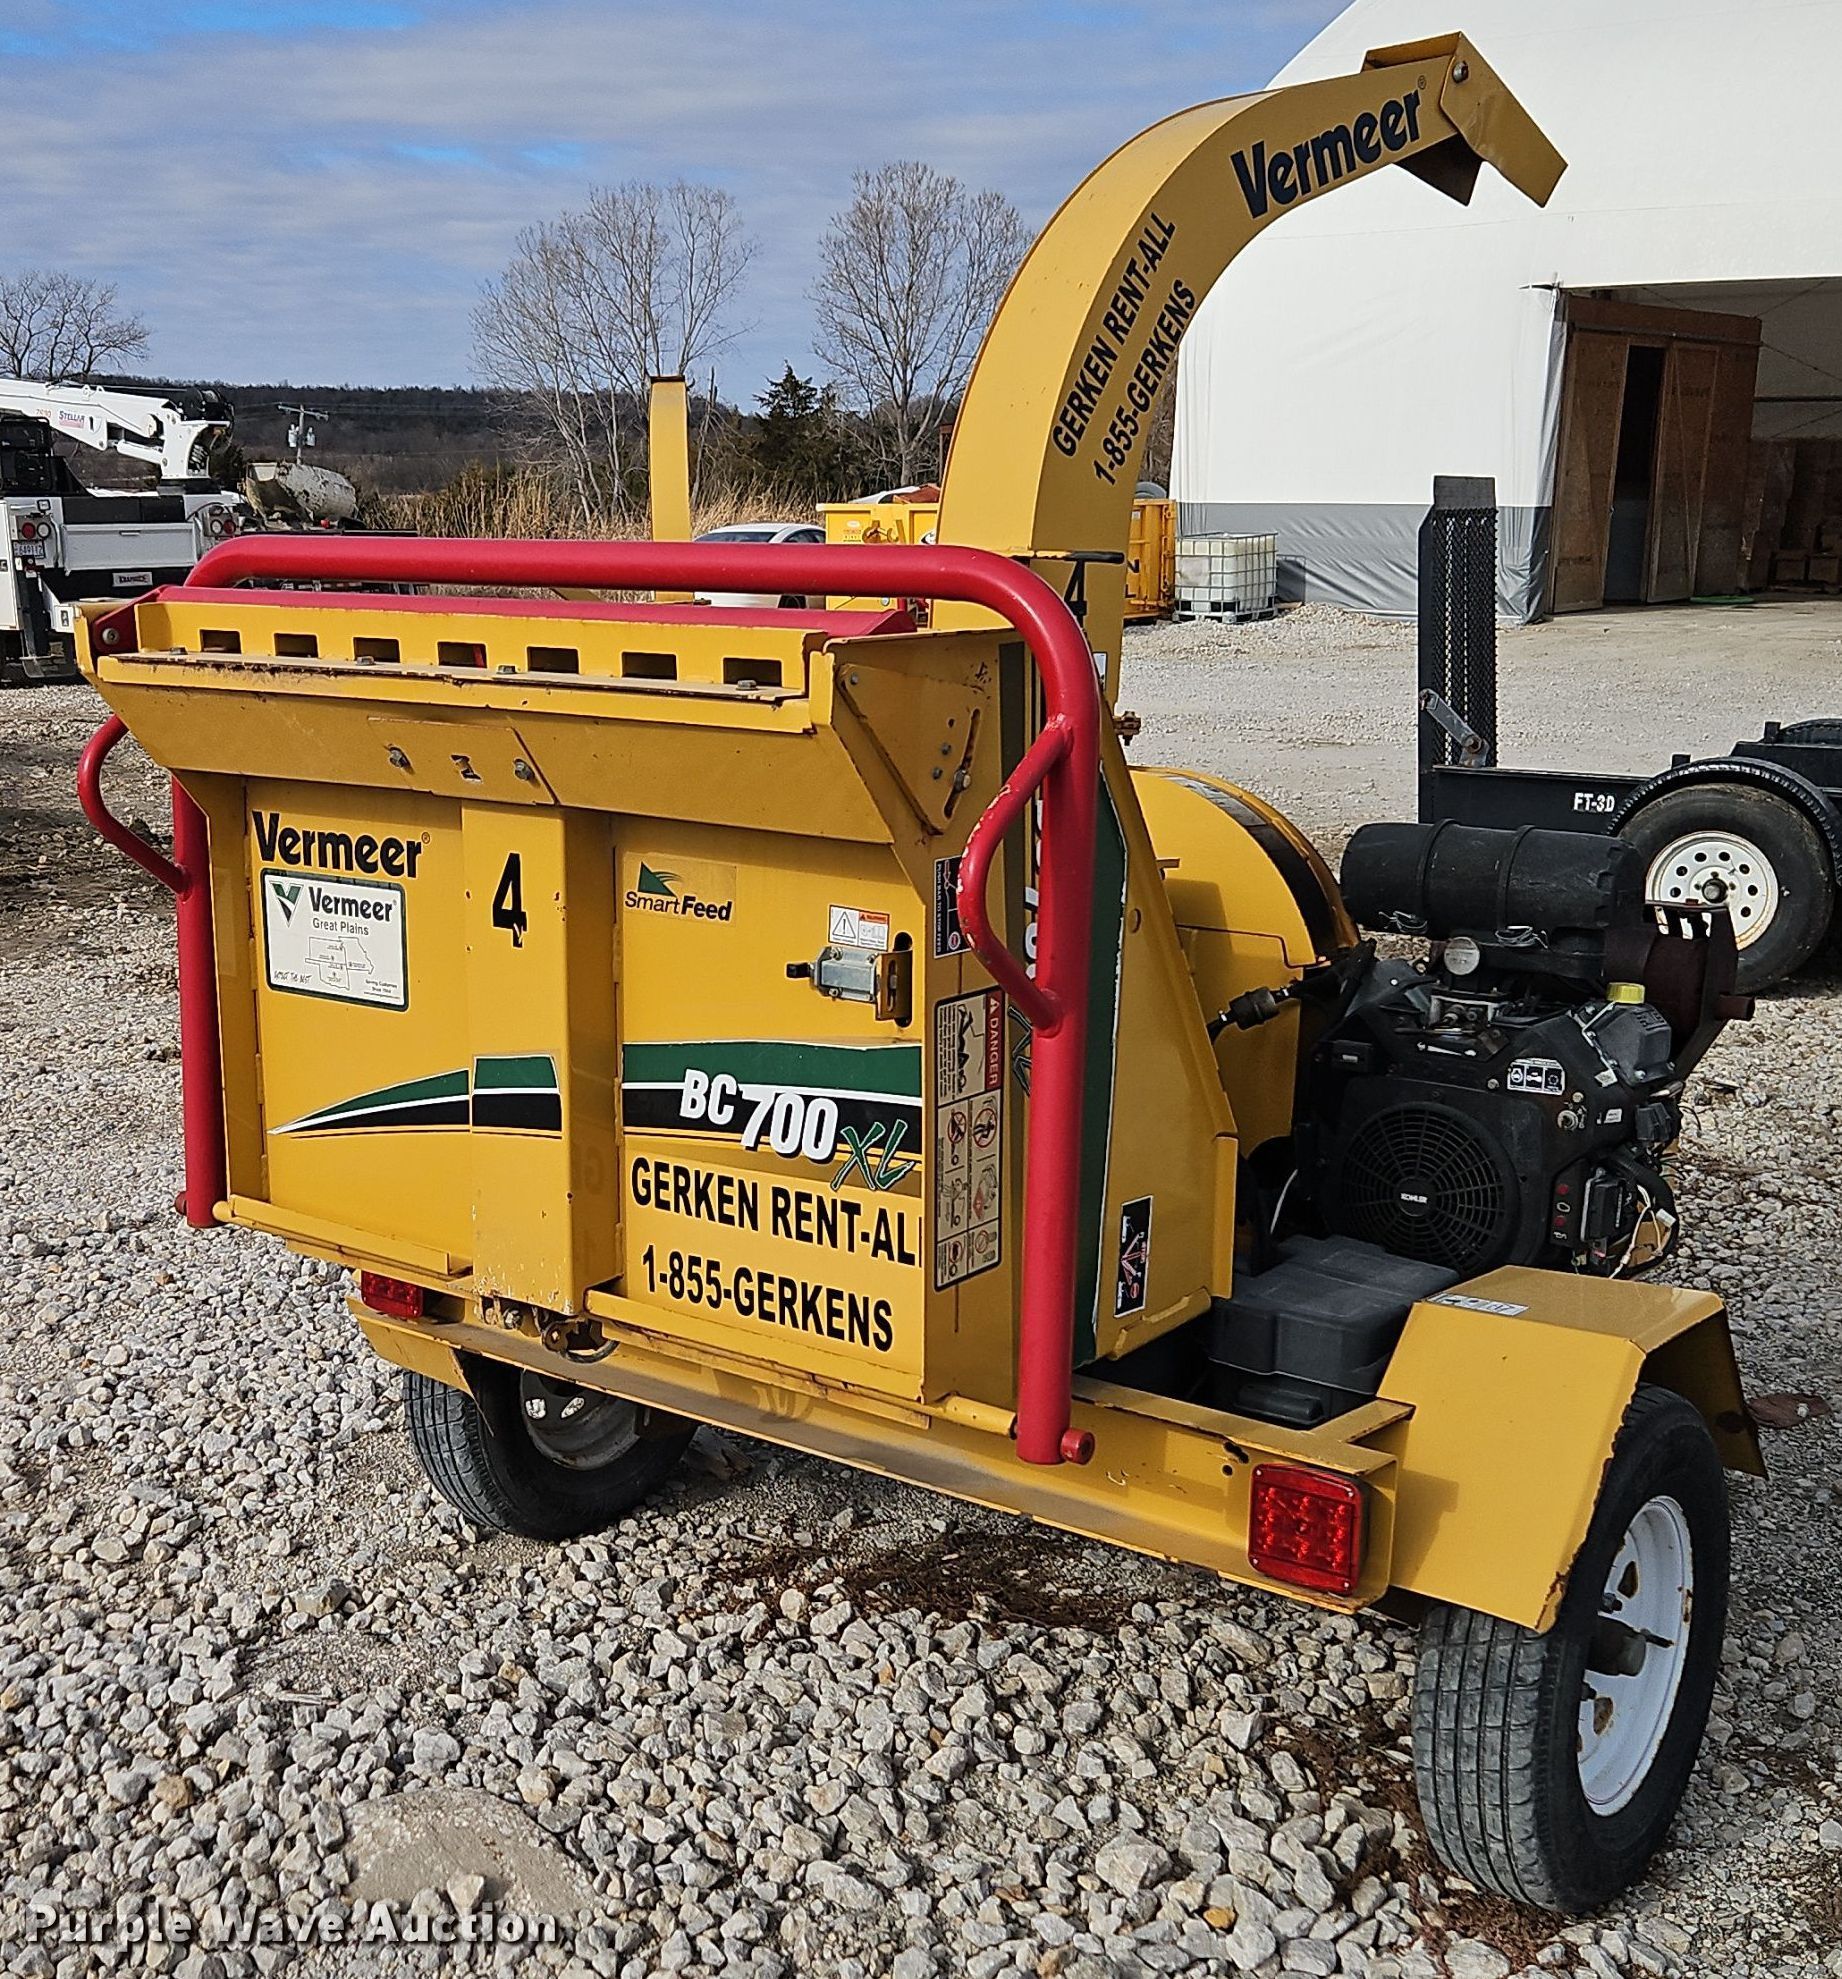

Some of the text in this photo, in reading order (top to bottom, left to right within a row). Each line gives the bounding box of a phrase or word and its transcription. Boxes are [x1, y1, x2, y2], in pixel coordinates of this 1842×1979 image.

[1230, 88, 1421, 219] Vermeer
[1052, 211, 1176, 457] GERKEN RENT-ALL
[1093, 278, 1197, 486] 1-855-GERKENS
[1573, 792, 1616, 812] FT-3D
[252, 810, 422, 878] Vermeer
[308, 886, 393, 922] Vermeer
[312, 917, 369, 936] Great Plains
[492, 852, 527, 949] 4
[624, 890, 733, 923] SmartFeed
[988, 1018, 999, 1087] DANGER
[632, 1156, 759, 1231] GERKEN
[642, 1245, 893, 1353] 1-855-GERKENS
